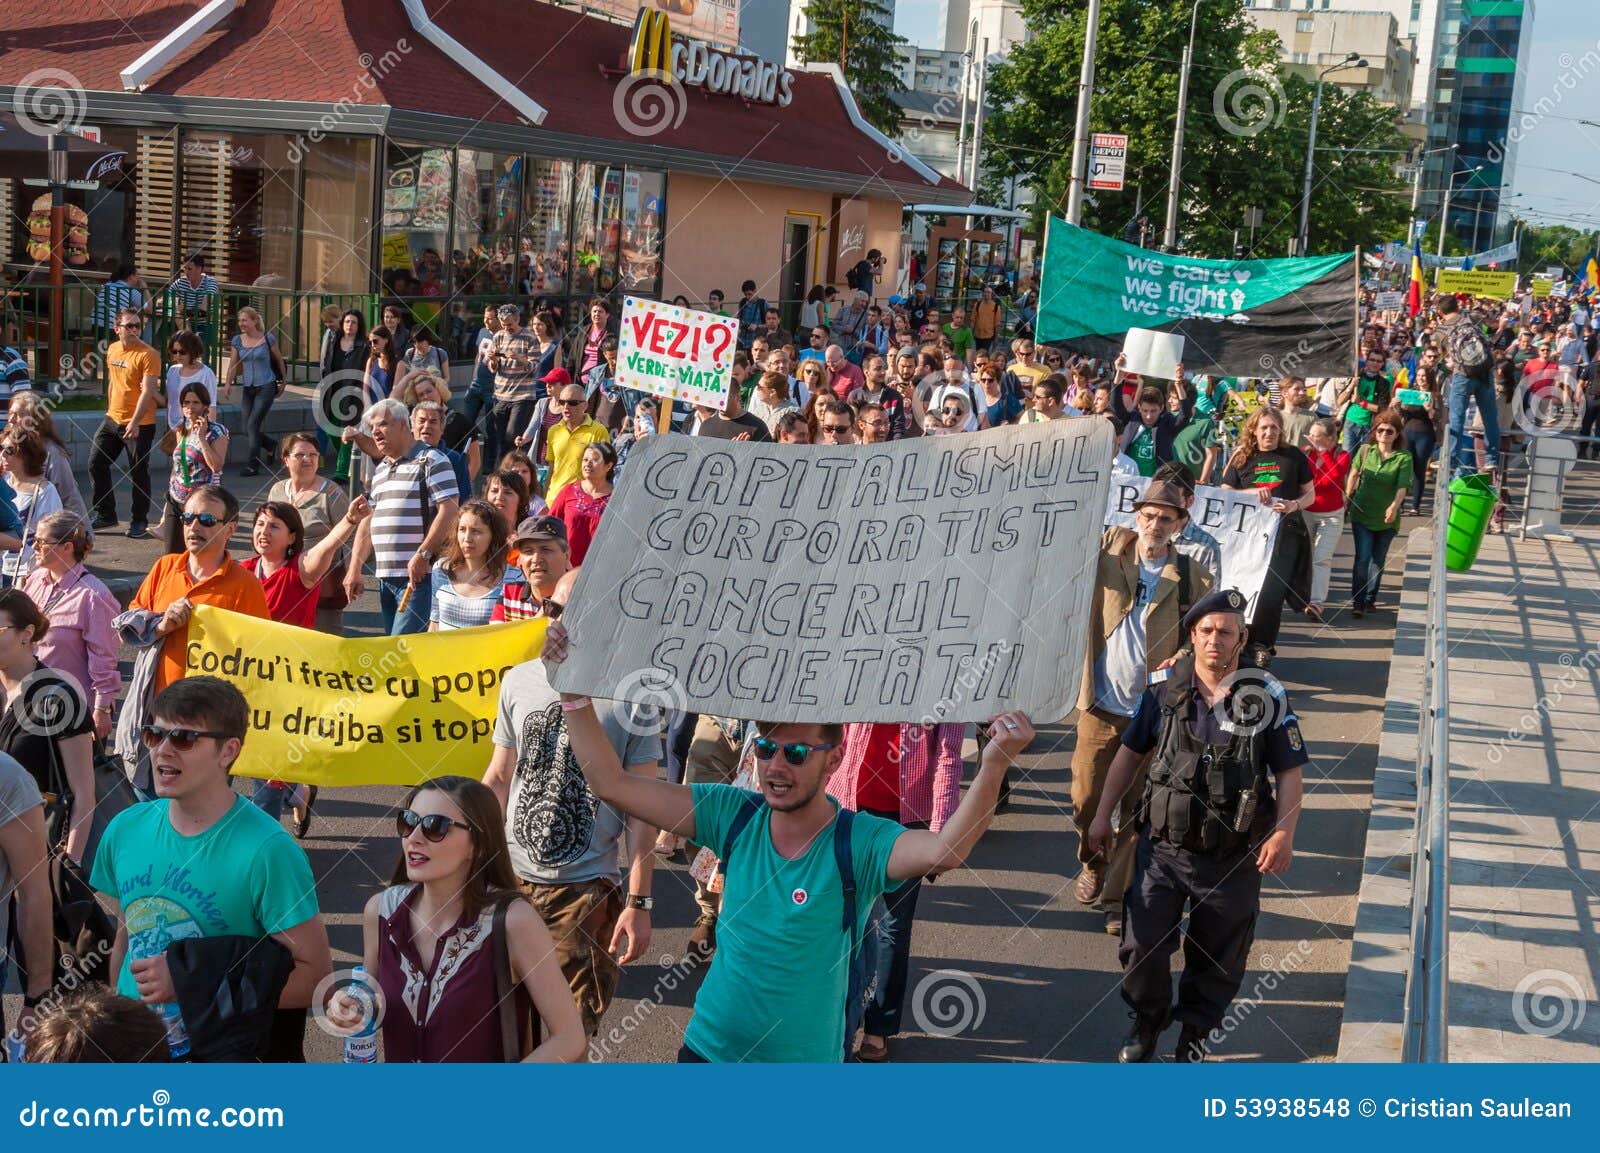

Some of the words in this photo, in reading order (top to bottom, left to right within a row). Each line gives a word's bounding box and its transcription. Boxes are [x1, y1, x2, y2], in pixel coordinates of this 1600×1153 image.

[628, 6, 796, 107] McDonald's
[1168, 280, 1228, 311] fight
[1173, 264, 1230, 284] care
[631, 311, 732, 369] VEZI?
[643, 435, 1100, 509] CAPITALISMUL
[647, 500, 1078, 565] CORPORATIST
[618, 567, 971, 639] CANCERUL
[300, 661, 374, 694] frate
[386, 676, 420, 699] cu
[282, 706, 384, 747] drujba
[396, 718, 422, 743] si
[432, 718, 497, 744] top
[120, 863, 153, 895] ard
